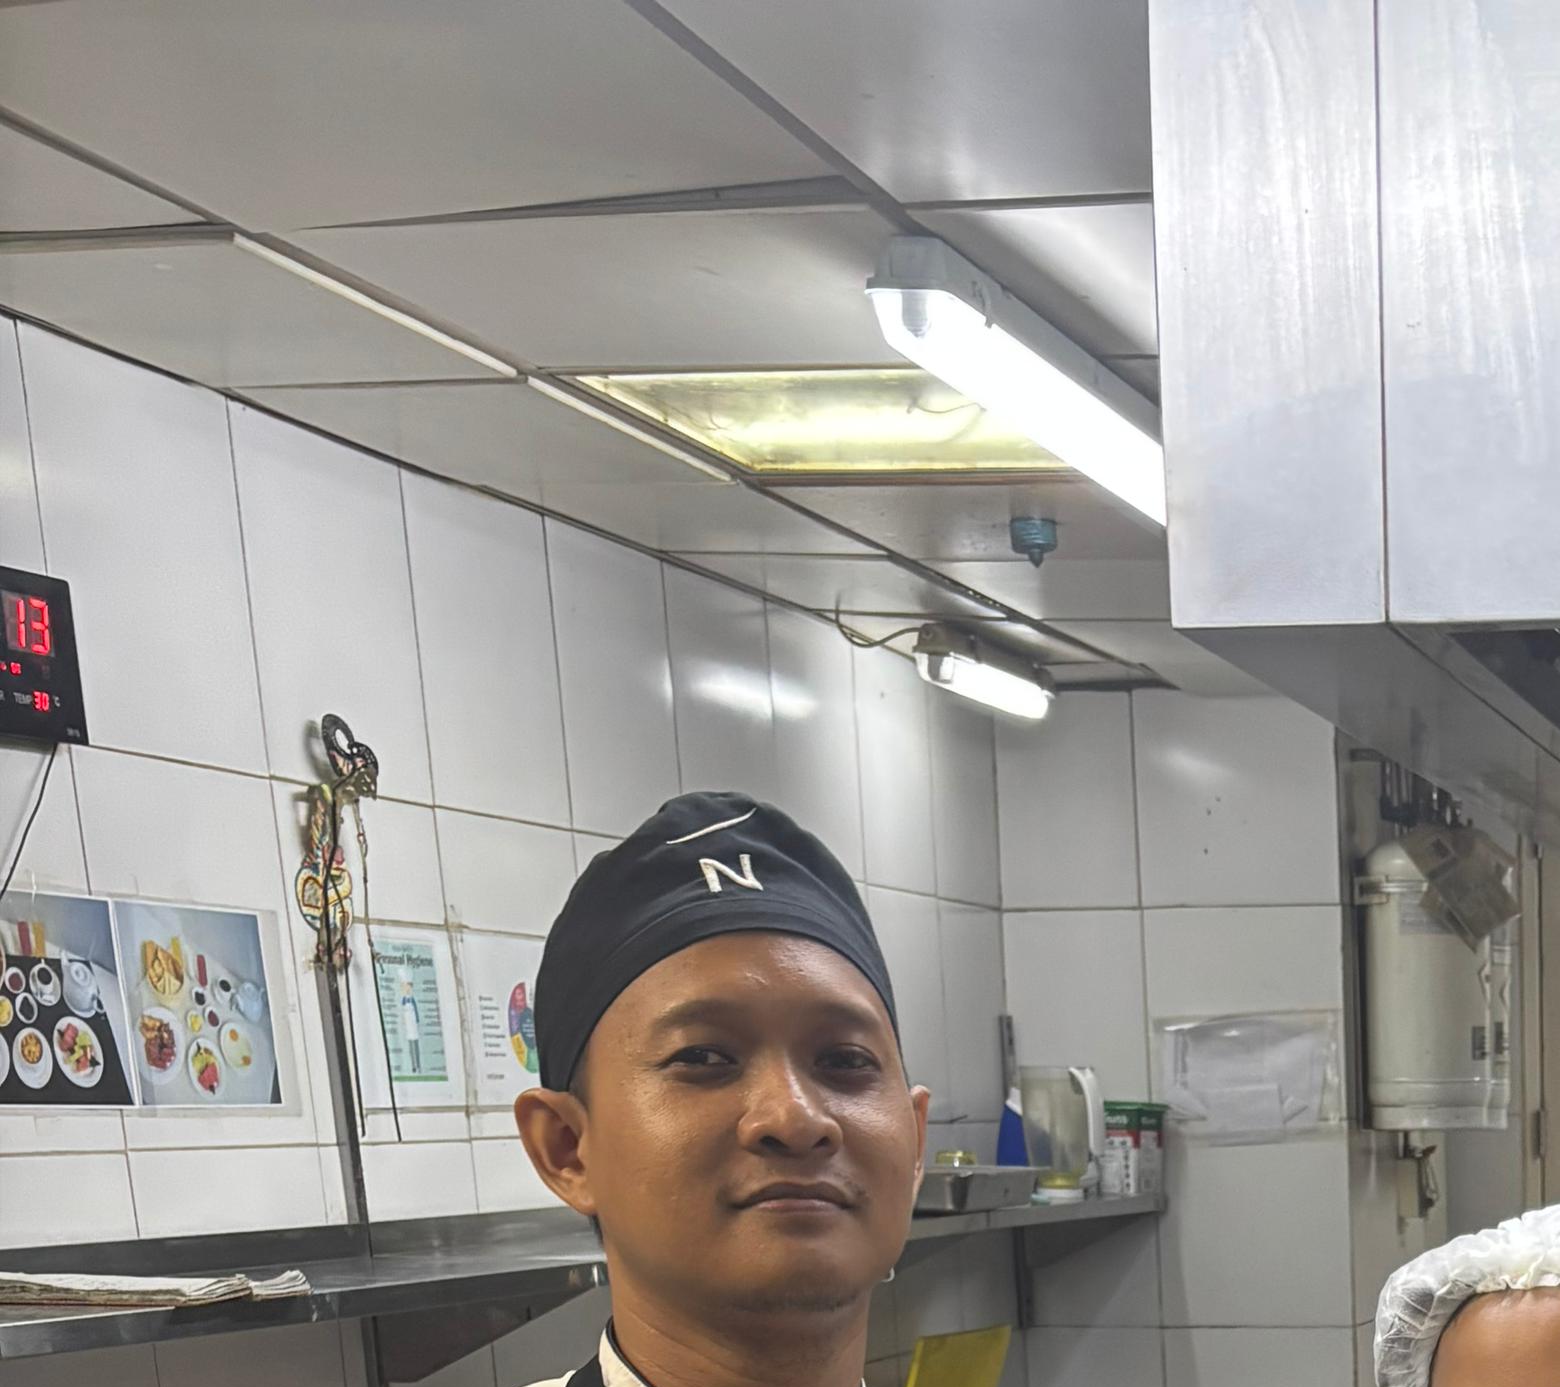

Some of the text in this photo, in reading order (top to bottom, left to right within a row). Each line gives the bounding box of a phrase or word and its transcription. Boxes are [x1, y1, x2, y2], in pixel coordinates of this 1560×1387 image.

[16, 597, 51, 656] 13
[33, 691, 50, 712] 30
[699, 853, 764, 893] N
